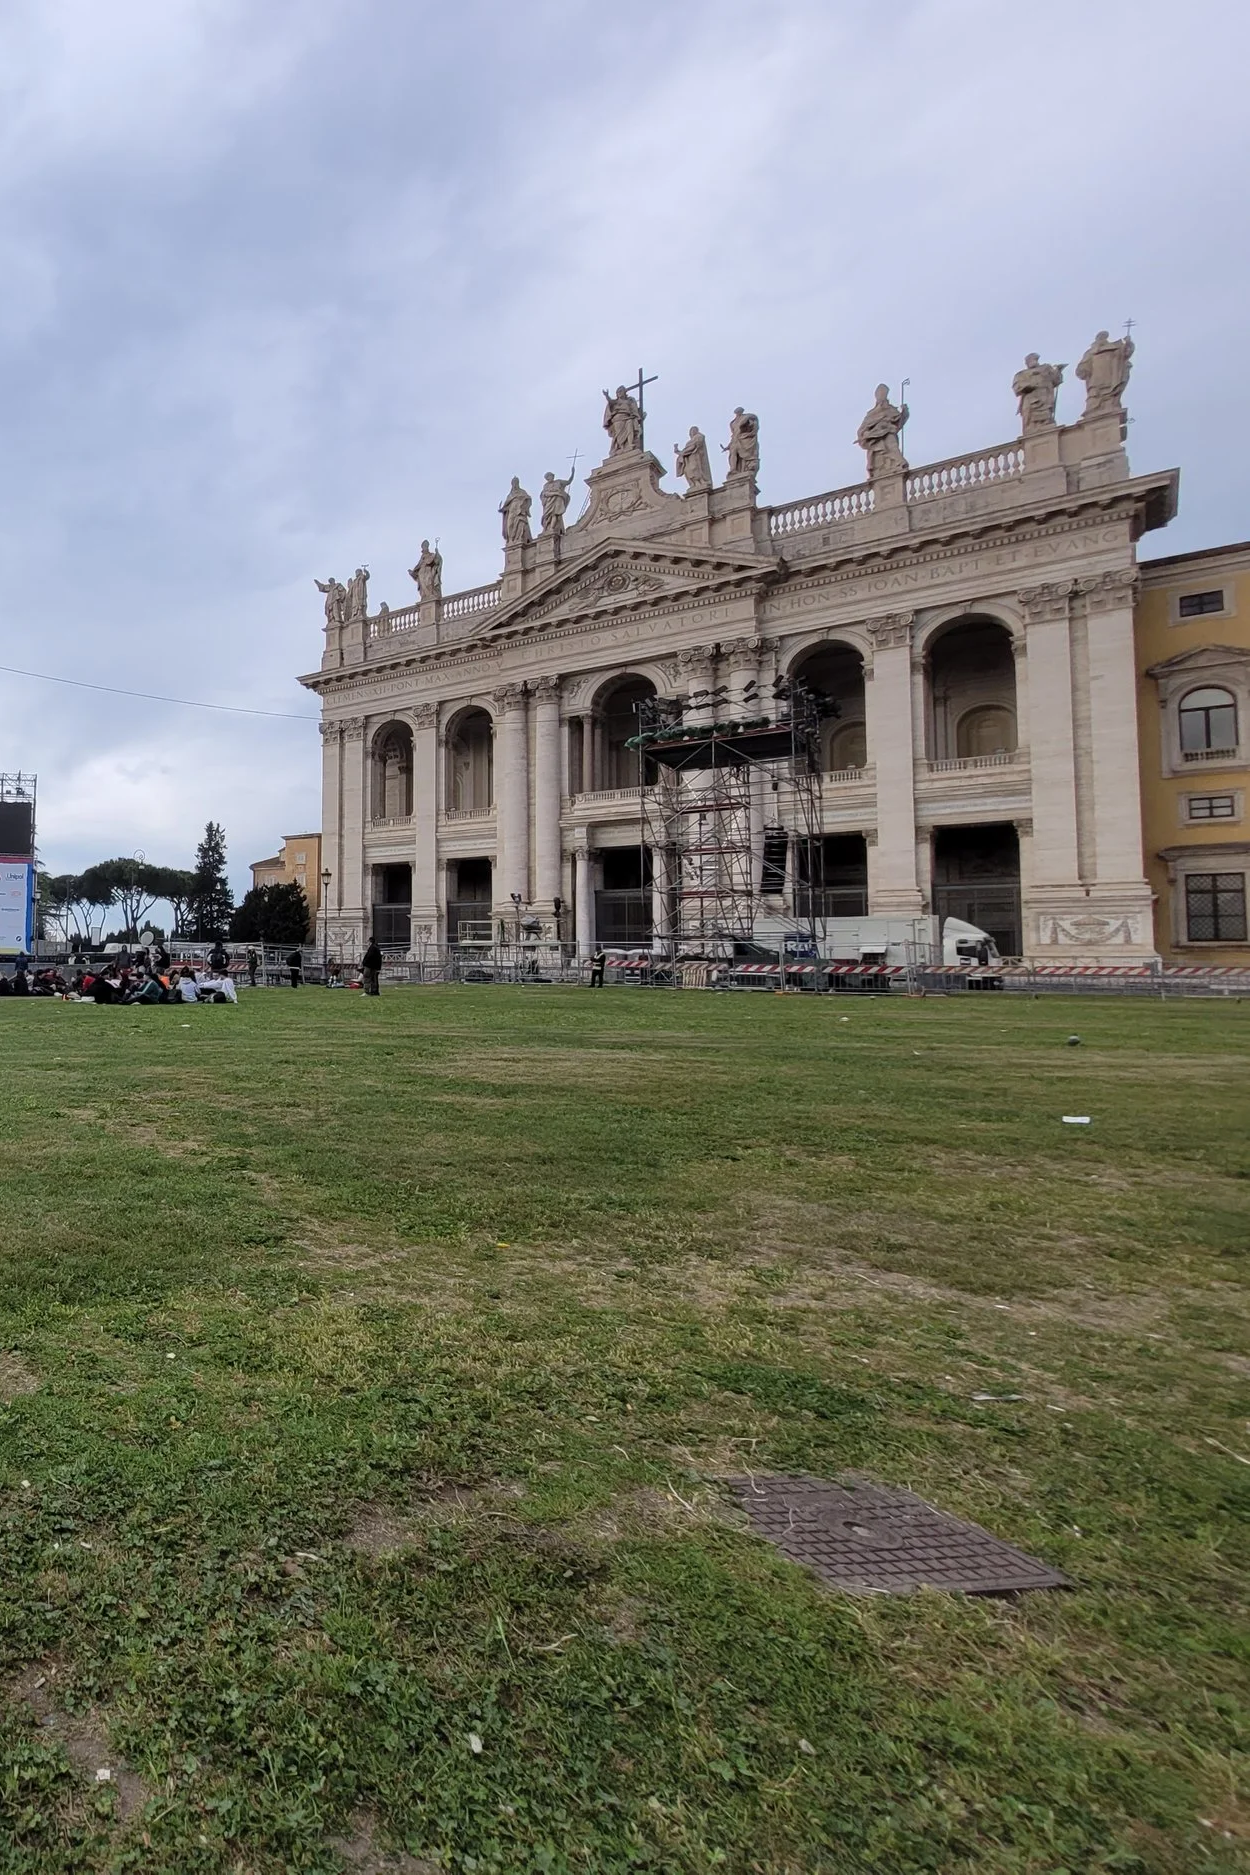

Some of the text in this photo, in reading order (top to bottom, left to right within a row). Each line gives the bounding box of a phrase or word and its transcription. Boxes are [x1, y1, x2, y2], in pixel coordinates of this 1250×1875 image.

[521, 607, 732, 660] CHRISTO SALVATORI
[6, 872, 24, 880] Unipol
